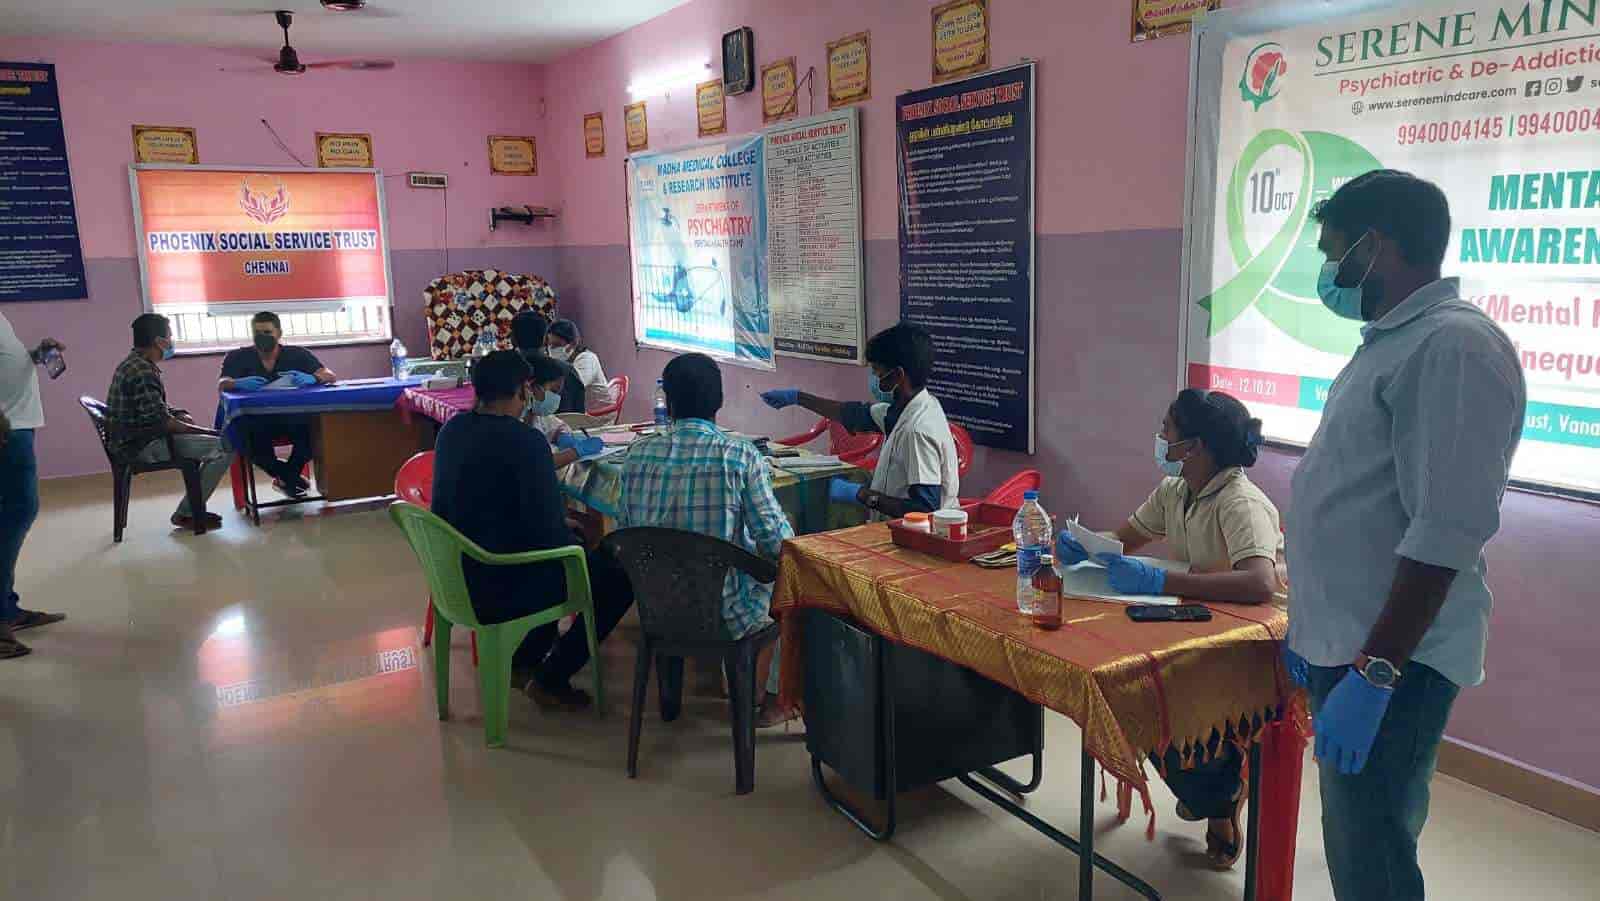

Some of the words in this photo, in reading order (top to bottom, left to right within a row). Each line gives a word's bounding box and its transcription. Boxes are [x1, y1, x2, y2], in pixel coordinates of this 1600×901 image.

[1314, 11, 1477, 68] SERENE
[1490, 0, 1600, 42] MIN
[1338, 65, 1444, 96] Psychiatric
[1450, 63, 1464, 80] &
[1367, 86, 1517, 112] www.serenemindcare.com
[1398, 116, 1503, 145] 9940004145
[1517, 108, 1600, 137] 9940004
[657, 162, 681, 177] MADHA
[682, 156, 715, 173] MEDICAL
[716, 150, 757, 169] COLLEGE
[670, 178, 705, 194] RESEARCH
[707, 172, 753, 190] INSTITUTE
[1488, 170, 1600, 210] MENTA
[1274, 192, 1294, 211] OCT
[687, 216, 753, 237] PSYCHIATRY
[149, 232, 217, 251] PHOENIX
[219, 232, 272, 250] SOCIAL
[274, 231, 331, 250] SERVICE
[334, 230, 377, 249] TRUST
[1460, 227, 1600, 265] AWAREN
[244, 260, 290, 275] CHENNAI
[1524, 413, 1553, 433] ust,
